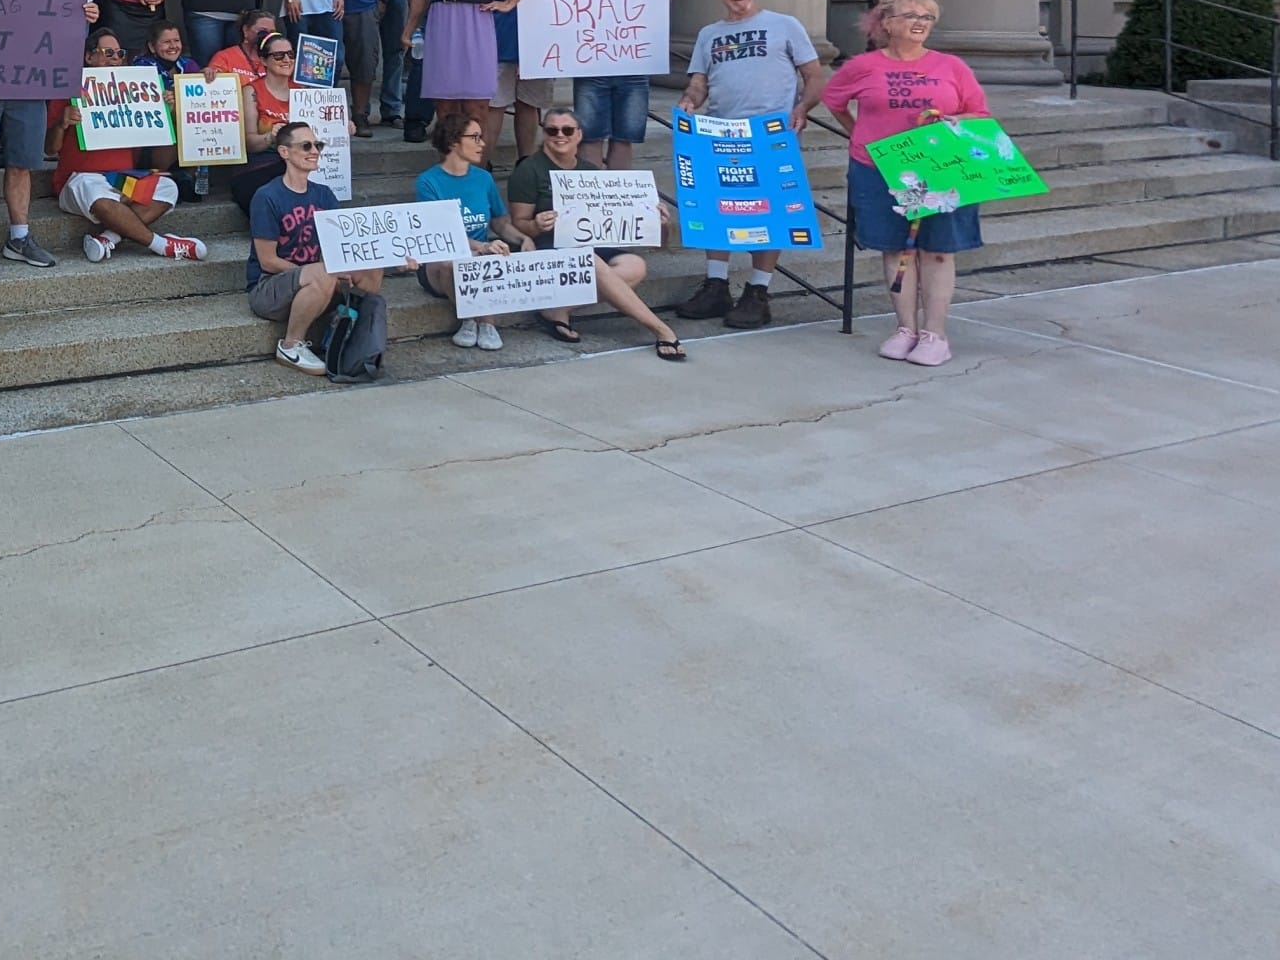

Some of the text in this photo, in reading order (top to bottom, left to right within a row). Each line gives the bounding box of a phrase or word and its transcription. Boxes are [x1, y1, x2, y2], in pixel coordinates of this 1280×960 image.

[576, 25, 647, 42] IS NOT
[711, 29, 767, 49] ANTI
[34, 31, 53, 55] A
[542, 42, 652, 72] A CRIME
[711, 45, 768, 65] NAZIS
[884, 71, 913, 79] WE
[888, 87, 912, 97] GO
[210, 100, 227, 109] MY
[888, 97, 933, 109] BACK
[186, 110, 240, 124] RIGHTS
[872, 147, 887, 159] I
[718, 166, 754, 175] FIGHT
[721, 174, 755, 182] HATE
[555, 173, 575, 191] We
[623, 178, 633, 189] to
[282, 204, 323, 232] DRA
[463, 213, 486, 224] SIVE
[600, 206, 613, 216] to
[338, 211, 398, 238] DRAG
[341, 232, 456, 264] FREE SPEECH
[458, 261, 482, 272] EVERY
[462, 272, 480, 282] DAY
[482, 260, 504, 280] 23
[505, 260, 526, 274] kids
[528, 261, 545, 272] are
[578, 254, 593, 268] US
[458, 285, 479, 299] Why
[559, 270, 592, 286] DRAG
